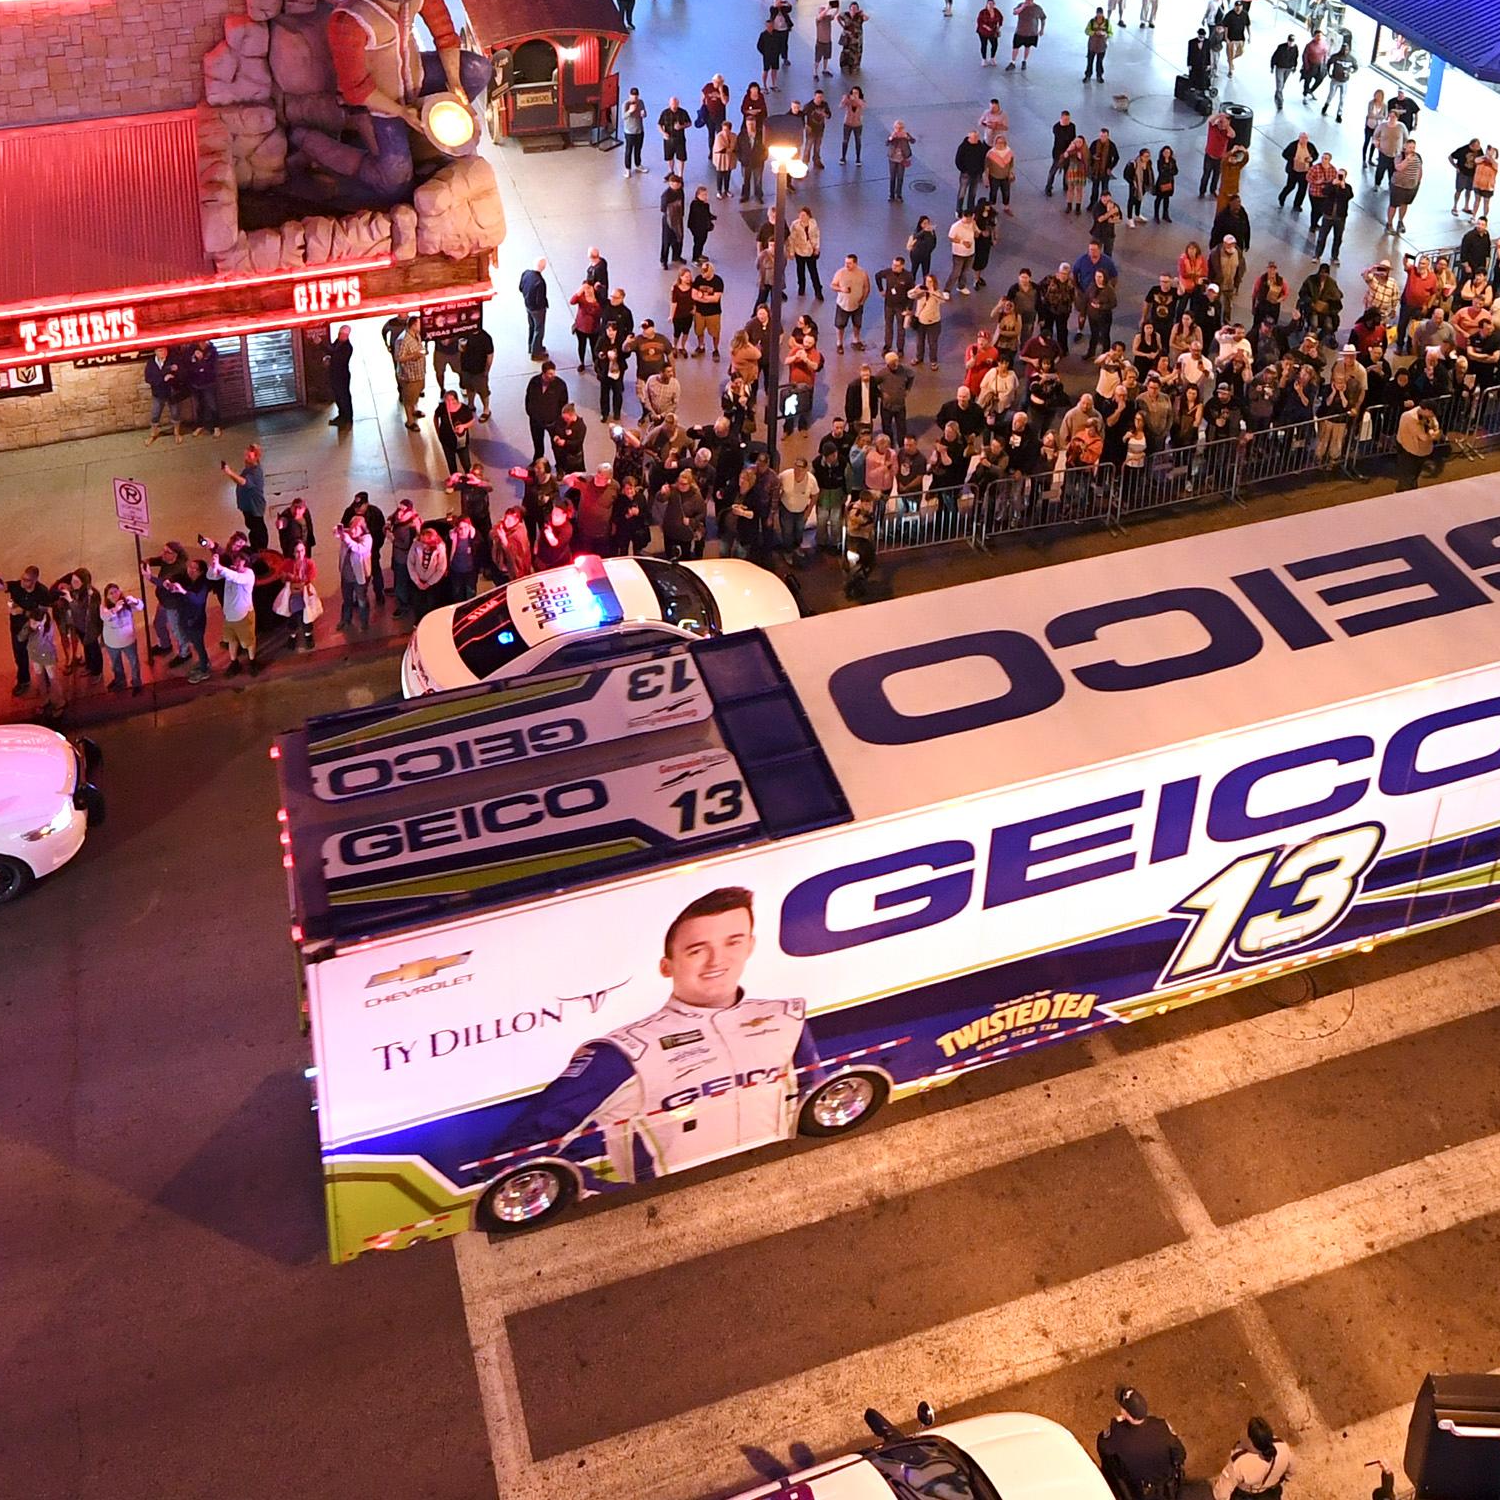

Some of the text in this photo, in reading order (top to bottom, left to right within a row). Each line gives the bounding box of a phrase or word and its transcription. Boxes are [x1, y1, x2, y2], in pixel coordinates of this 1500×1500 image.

[293, 275, 362, 314] GIFTS
[18, 306, 138, 352] T-SHIRTS
[426, 329, 450, 339] VEGAS
[525, 581, 557, 630] MARSHAL
[628, 652, 696, 702] 13
[329, 717, 587, 796] GEICO
[339, 778, 609, 867] GEICO
[669, 780, 744, 835] 13
[1156, 821, 1386, 990] 13
[364, 972, 477, 1009] CHEVROLET
[430, 1002, 564, 1059] DILLON
[936, 998, 1051, 1058] TWISTED
[1049, 992, 1099, 1020] TEA
[976, 1022, 1060, 1051] HARD ICED TEA
